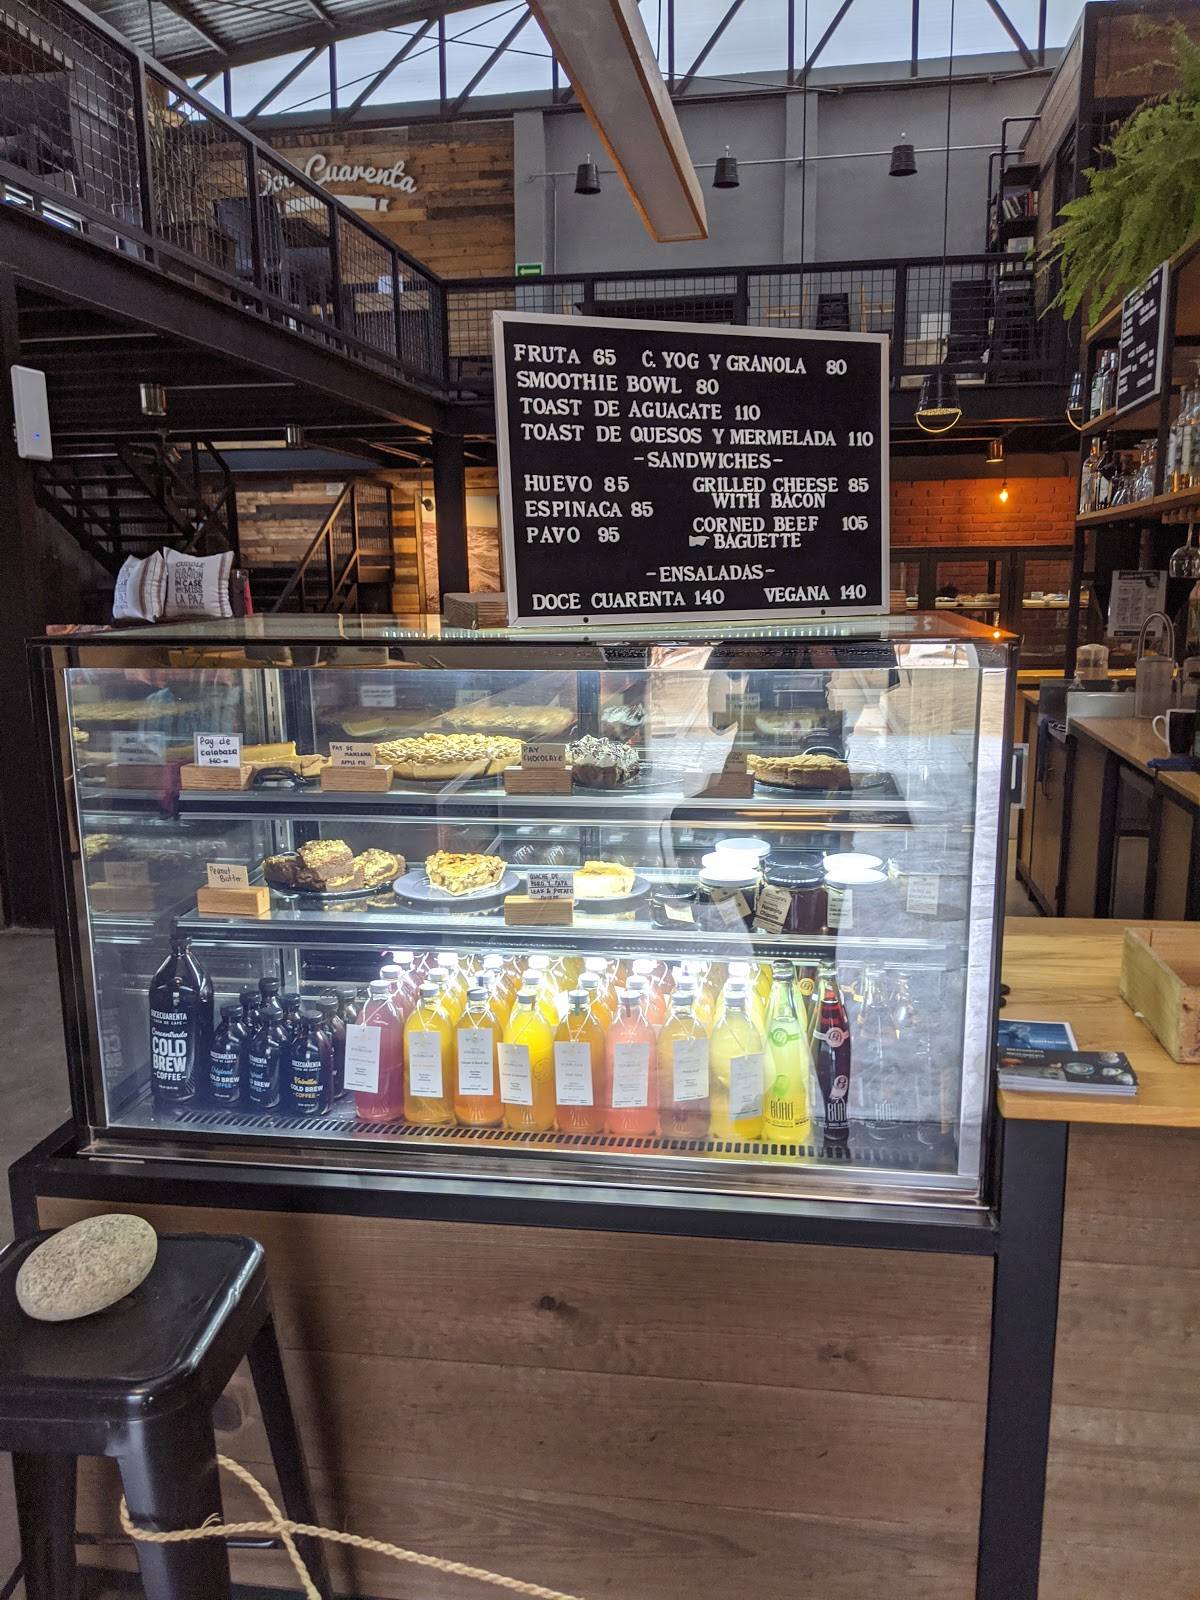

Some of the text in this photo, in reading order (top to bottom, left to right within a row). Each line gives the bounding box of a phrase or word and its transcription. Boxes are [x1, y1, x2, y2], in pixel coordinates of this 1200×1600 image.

[304, 153, 417, 194] Cuarenta
[514, 344, 617, 366] FRUTA 65
[642, 350, 847, 375] C. YOG Y GRANOLA 80
[516, 371, 719, 395] SMOOTHIE BOWL 80
[520, 397, 761, 421] TOAST DE AGUACATE 110
[521, 423, 873, 447] TOAST DE QUESOS Y MERMELADA 110
[524, 475, 629, 493] HUEVO 85
[692, 477, 869, 493] GRILLED CHEESE 85
[525, 500, 654, 518] ESPINACA 85
[712, 493, 827, 509] WITH BACON
[693, 516, 868, 534] CORNED BEEF 105
[527, 526, 620, 544] PAVO 95
[713, 533, 802, 549] BAGUETTE
[532, 584, 867, 611] DOCE CUARENTA 140 VEGANA 140
[200, 736, 230, 748] Pay de
[151, 1026, 188, 1038] Concentrado
[152, 1036, 187, 1057] COLD
[152, 1053, 187, 1073] BREW
[253, 1080, 271, 1088] BREW
[290, 1083, 304, 1092] COLD
